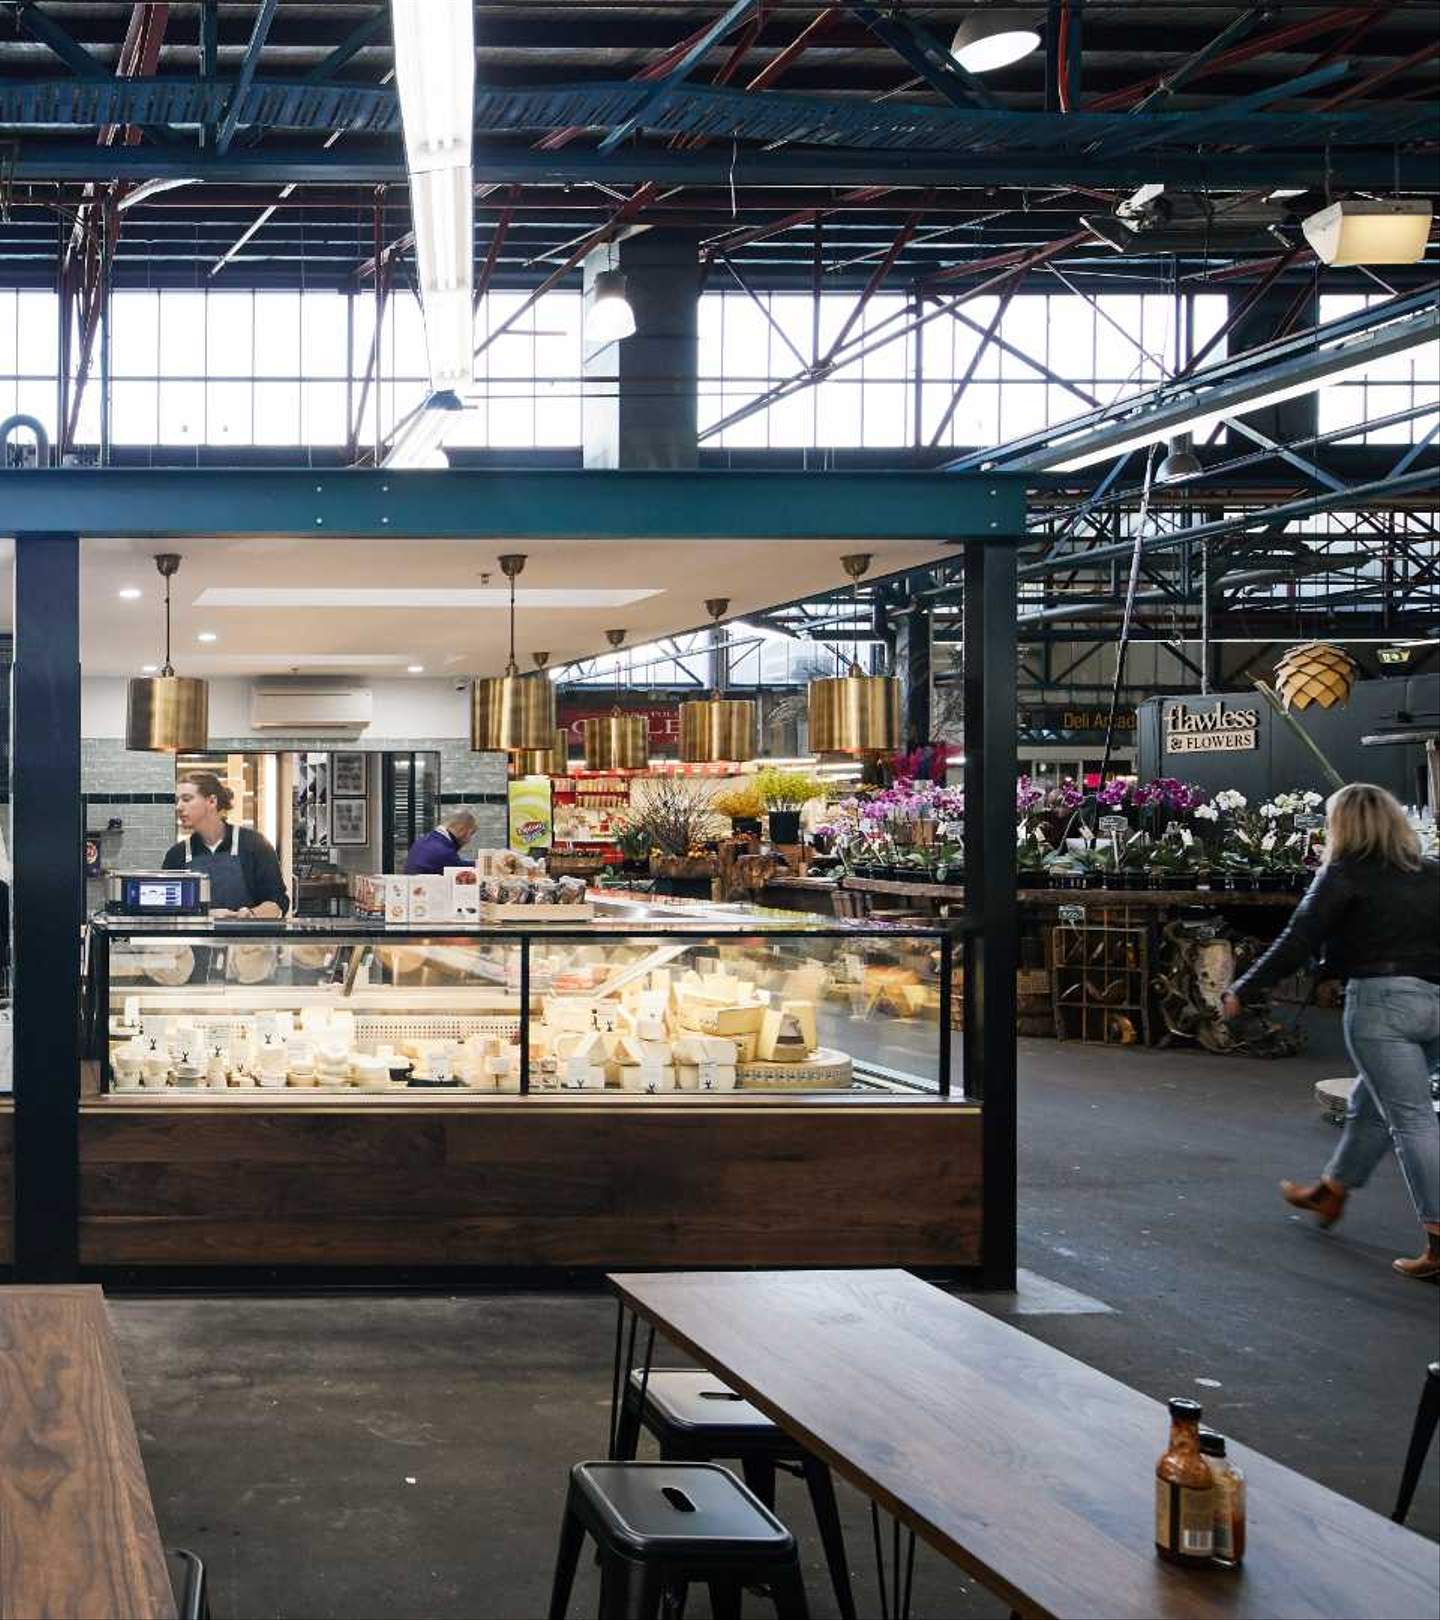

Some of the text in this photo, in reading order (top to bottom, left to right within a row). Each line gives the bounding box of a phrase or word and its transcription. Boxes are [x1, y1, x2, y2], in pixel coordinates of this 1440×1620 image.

[1064, 711, 1137, 729] Deli Arad
[1163, 701, 1257, 733] flawless
[1187, 734, 1252, 749] FLOWERS
